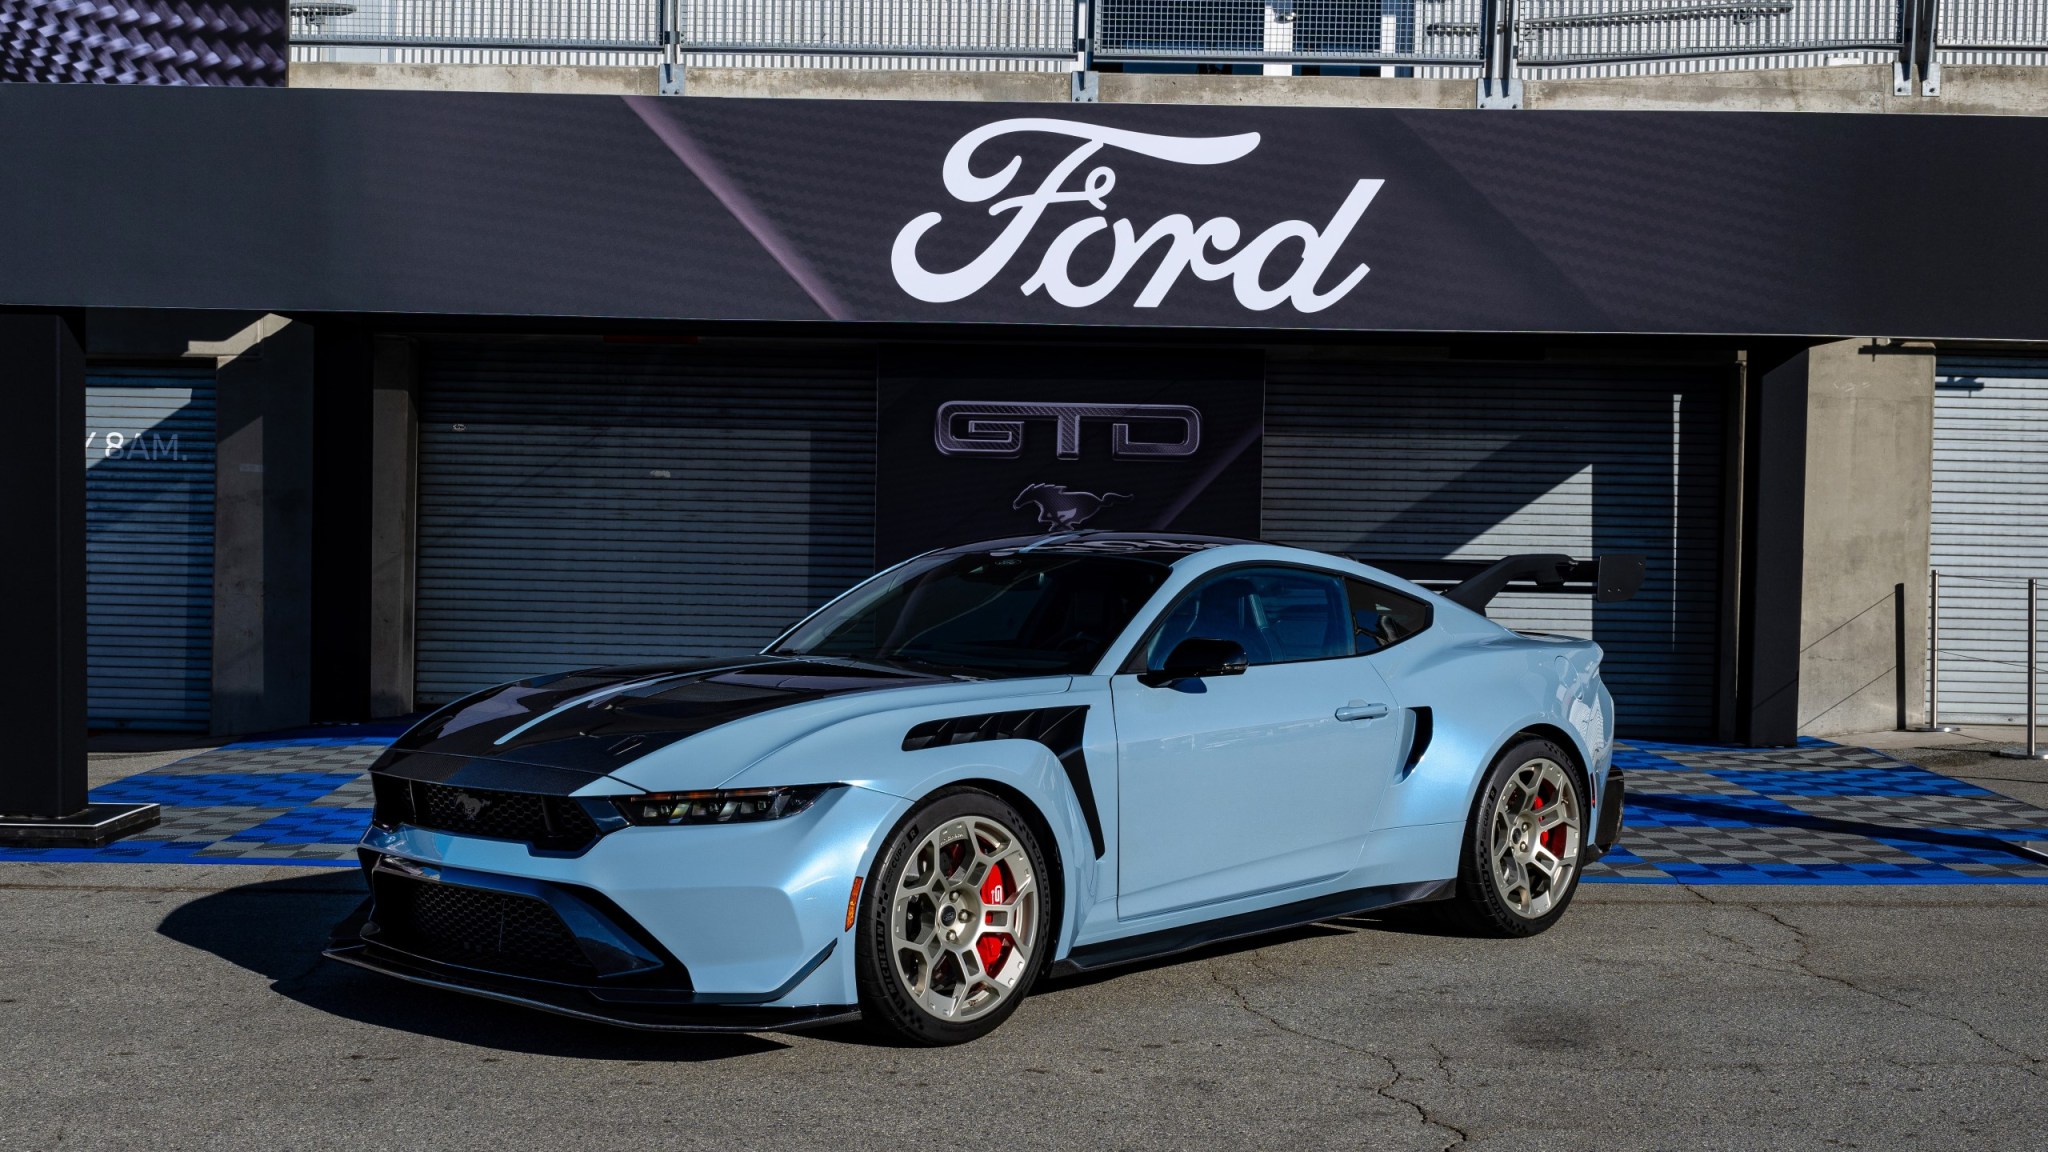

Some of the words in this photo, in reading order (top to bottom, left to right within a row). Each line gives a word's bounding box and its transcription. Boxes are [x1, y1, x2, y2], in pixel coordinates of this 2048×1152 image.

[891, 117, 1386, 313] Ford
[105, 431, 188, 461] 8AM.
[934, 400, 1201, 460] GTD
[891, 848, 903, 868] CUP
